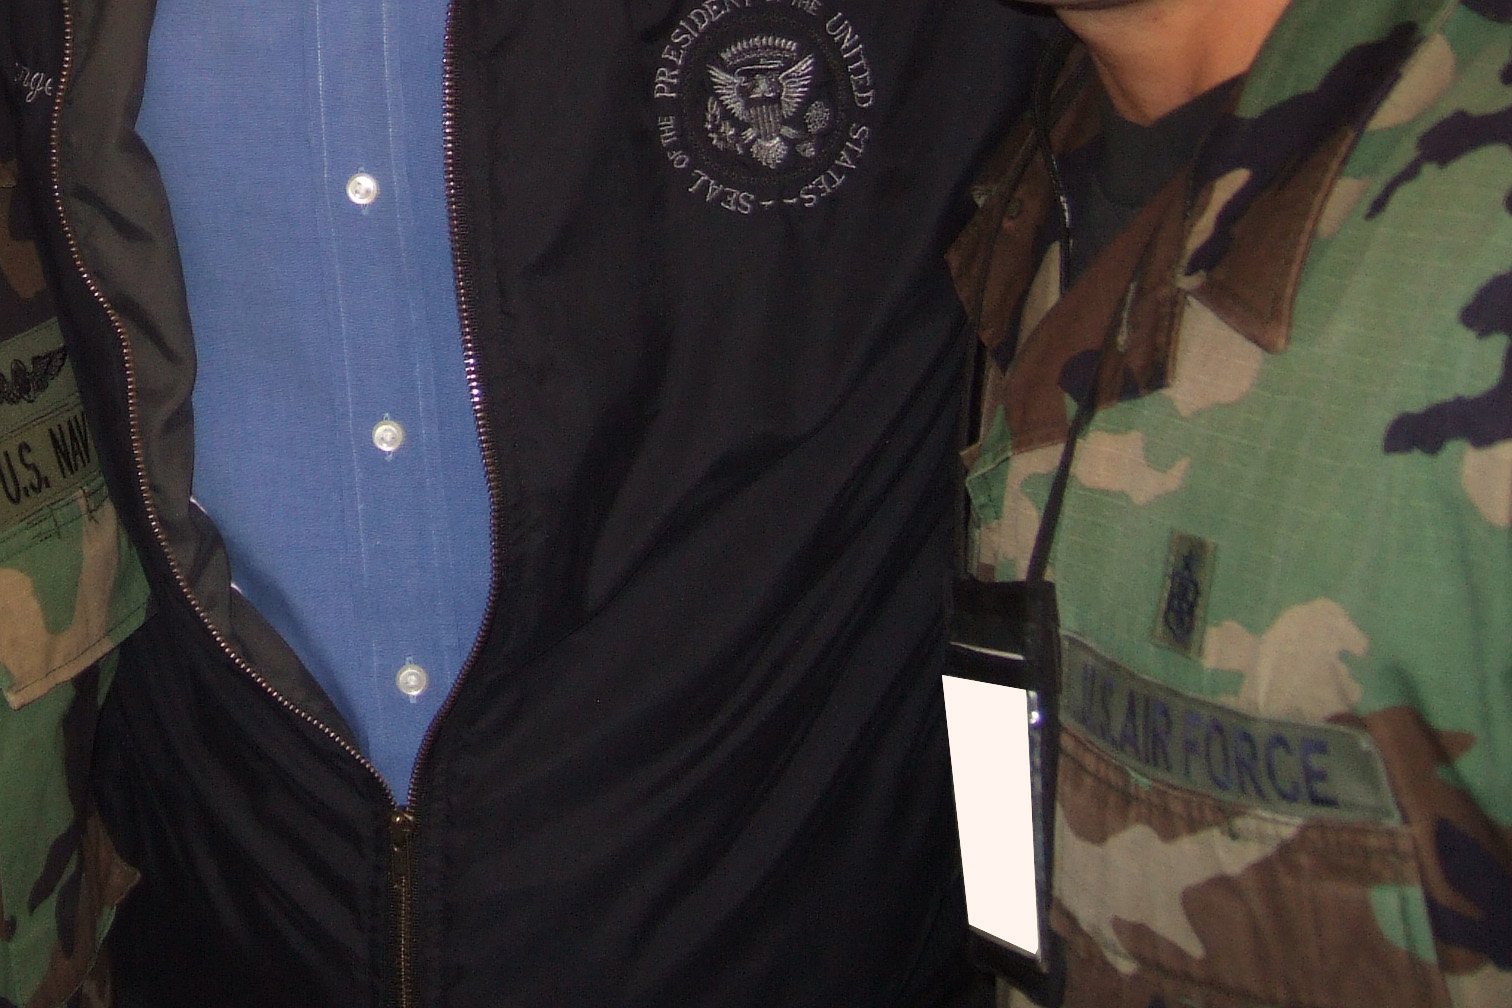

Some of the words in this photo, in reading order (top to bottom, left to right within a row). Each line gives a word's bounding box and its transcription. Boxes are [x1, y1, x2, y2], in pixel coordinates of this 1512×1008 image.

[825, 11, 875, 108] UNITED
[658, 115, 677, 146] THE
[667, 150, 689, 169] OF
[799, 122, 870, 208] STATES
[688, 169, 755, 215] SEAL
[48, 410, 90, 479] NAV
[1182, 709, 1339, 809] FORCE
